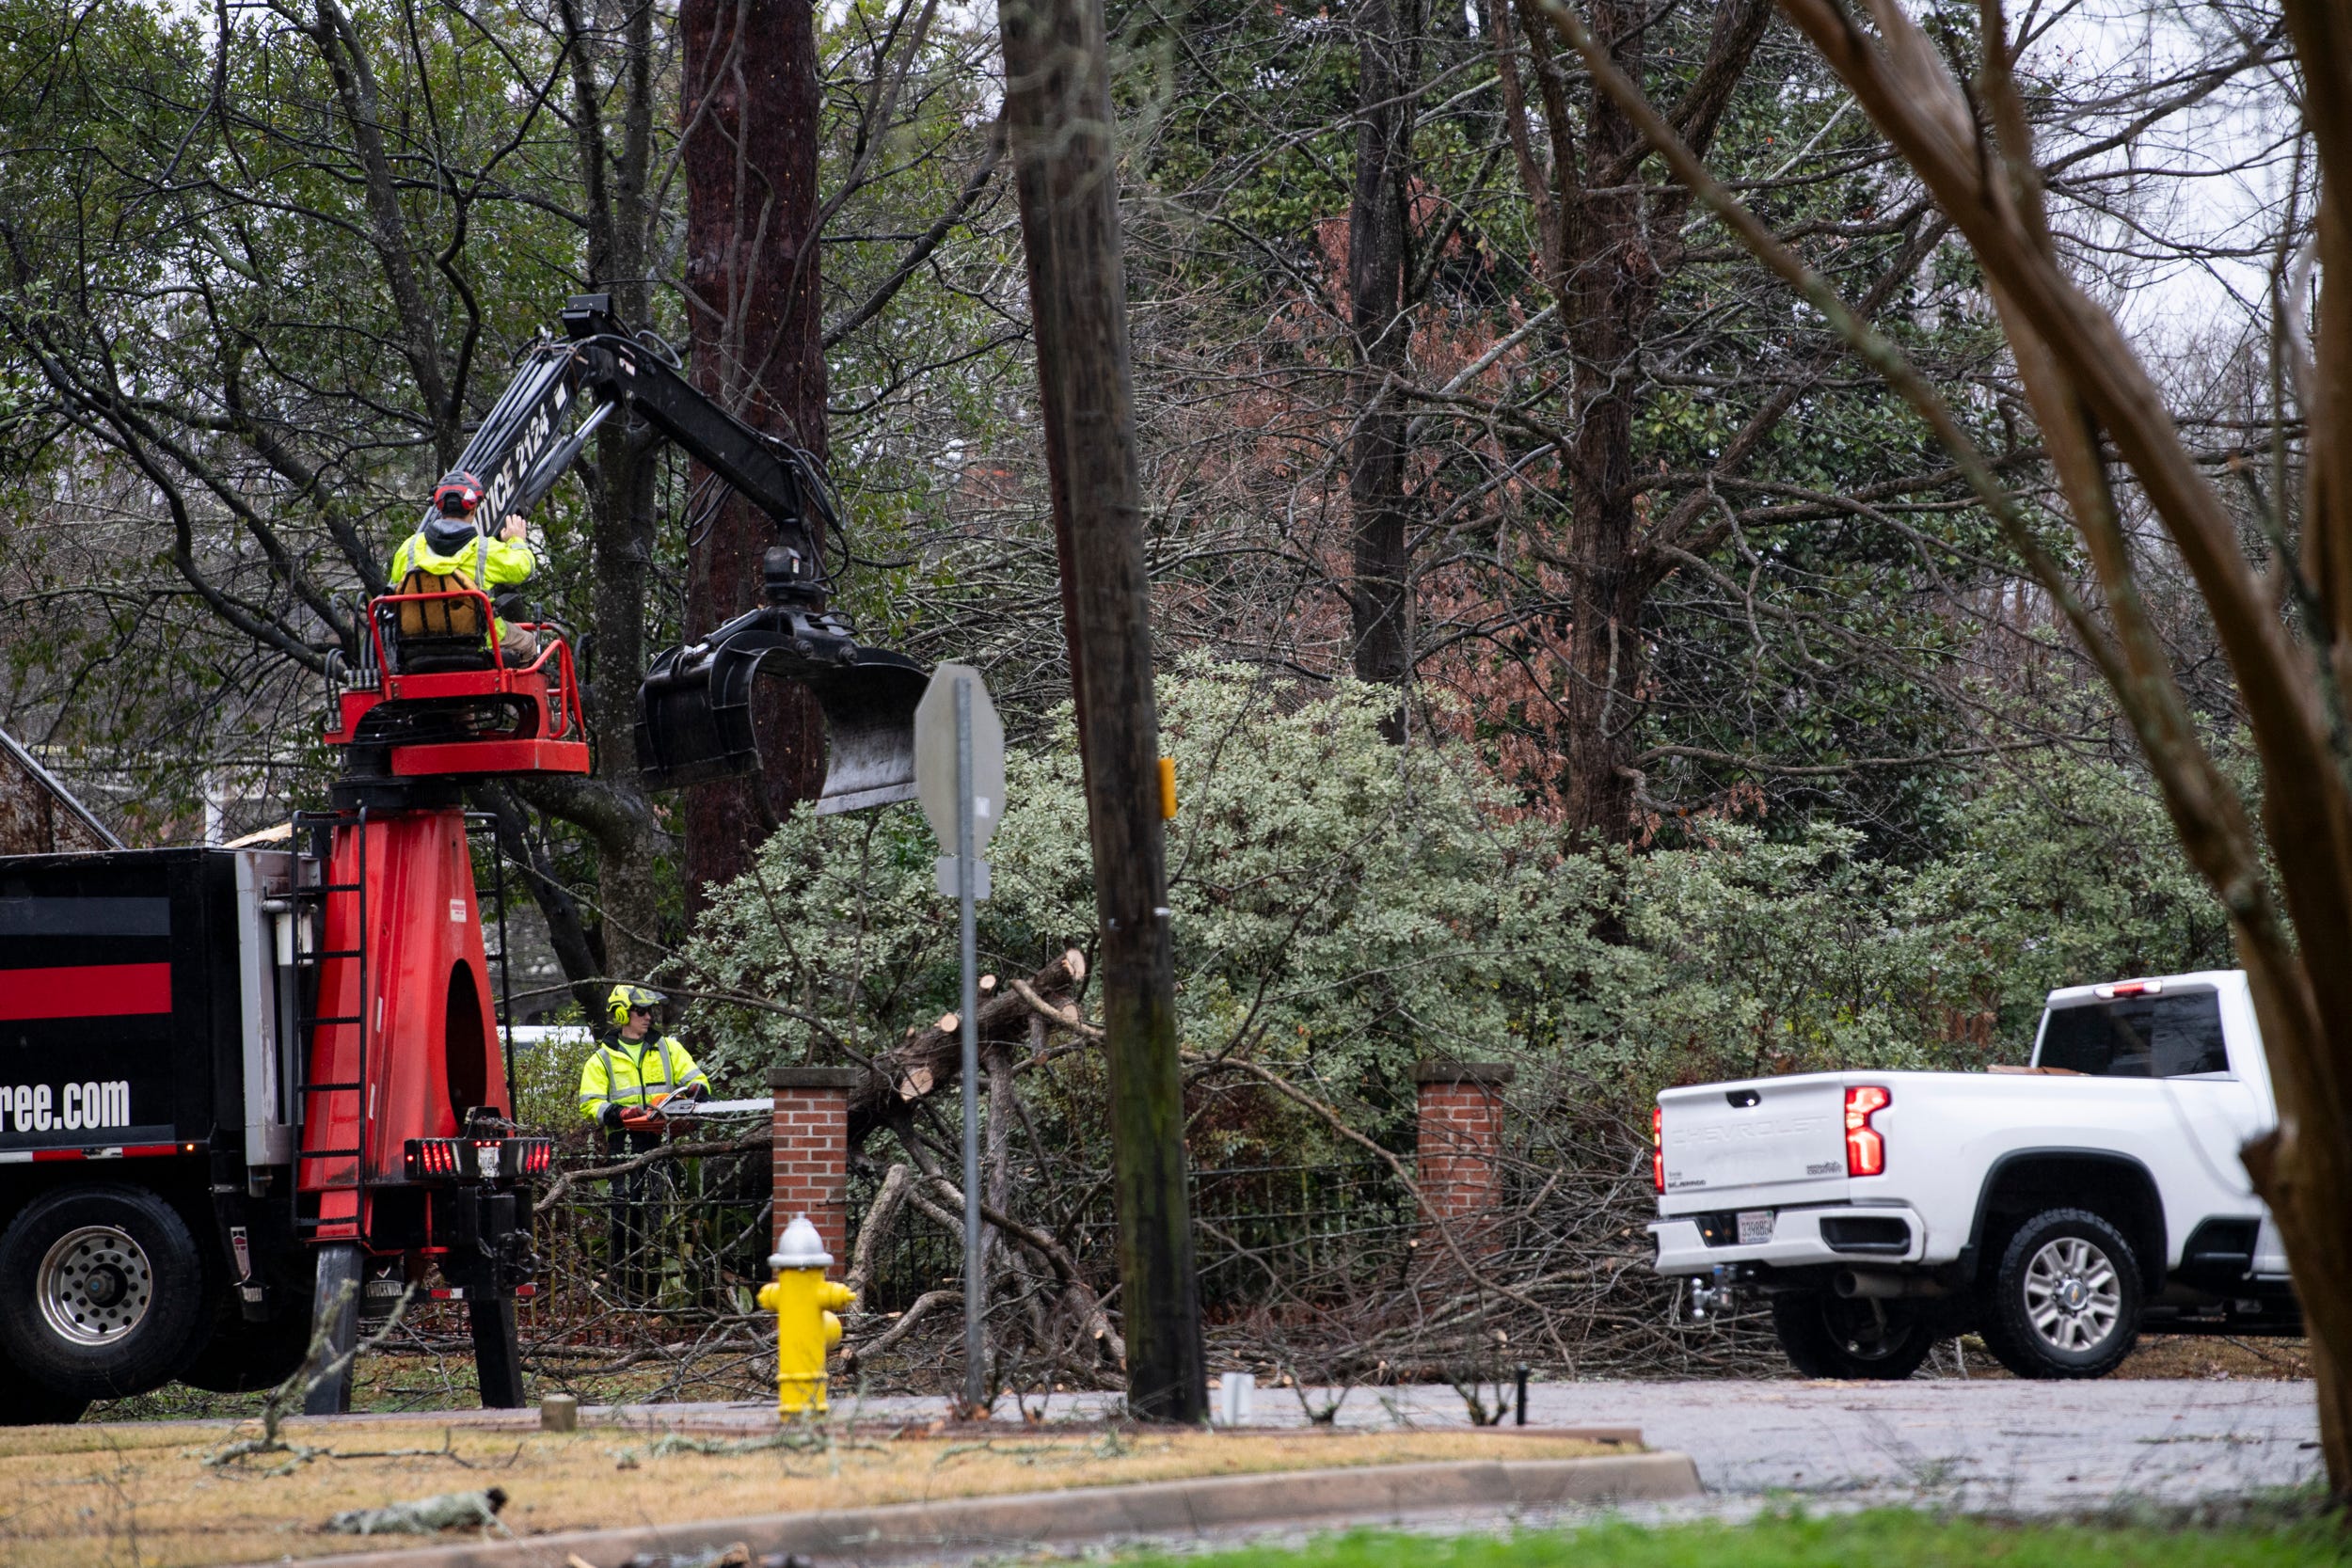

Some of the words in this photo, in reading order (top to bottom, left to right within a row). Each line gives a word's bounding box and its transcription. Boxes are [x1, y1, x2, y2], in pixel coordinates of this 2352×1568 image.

[471, 456, 515, 536] NTICE
[516, 402, 549, 480] 2124
[0, 1080, 130, 1132] ree.com
[1671, 1116, 1830, 1148] CHEVROLET
